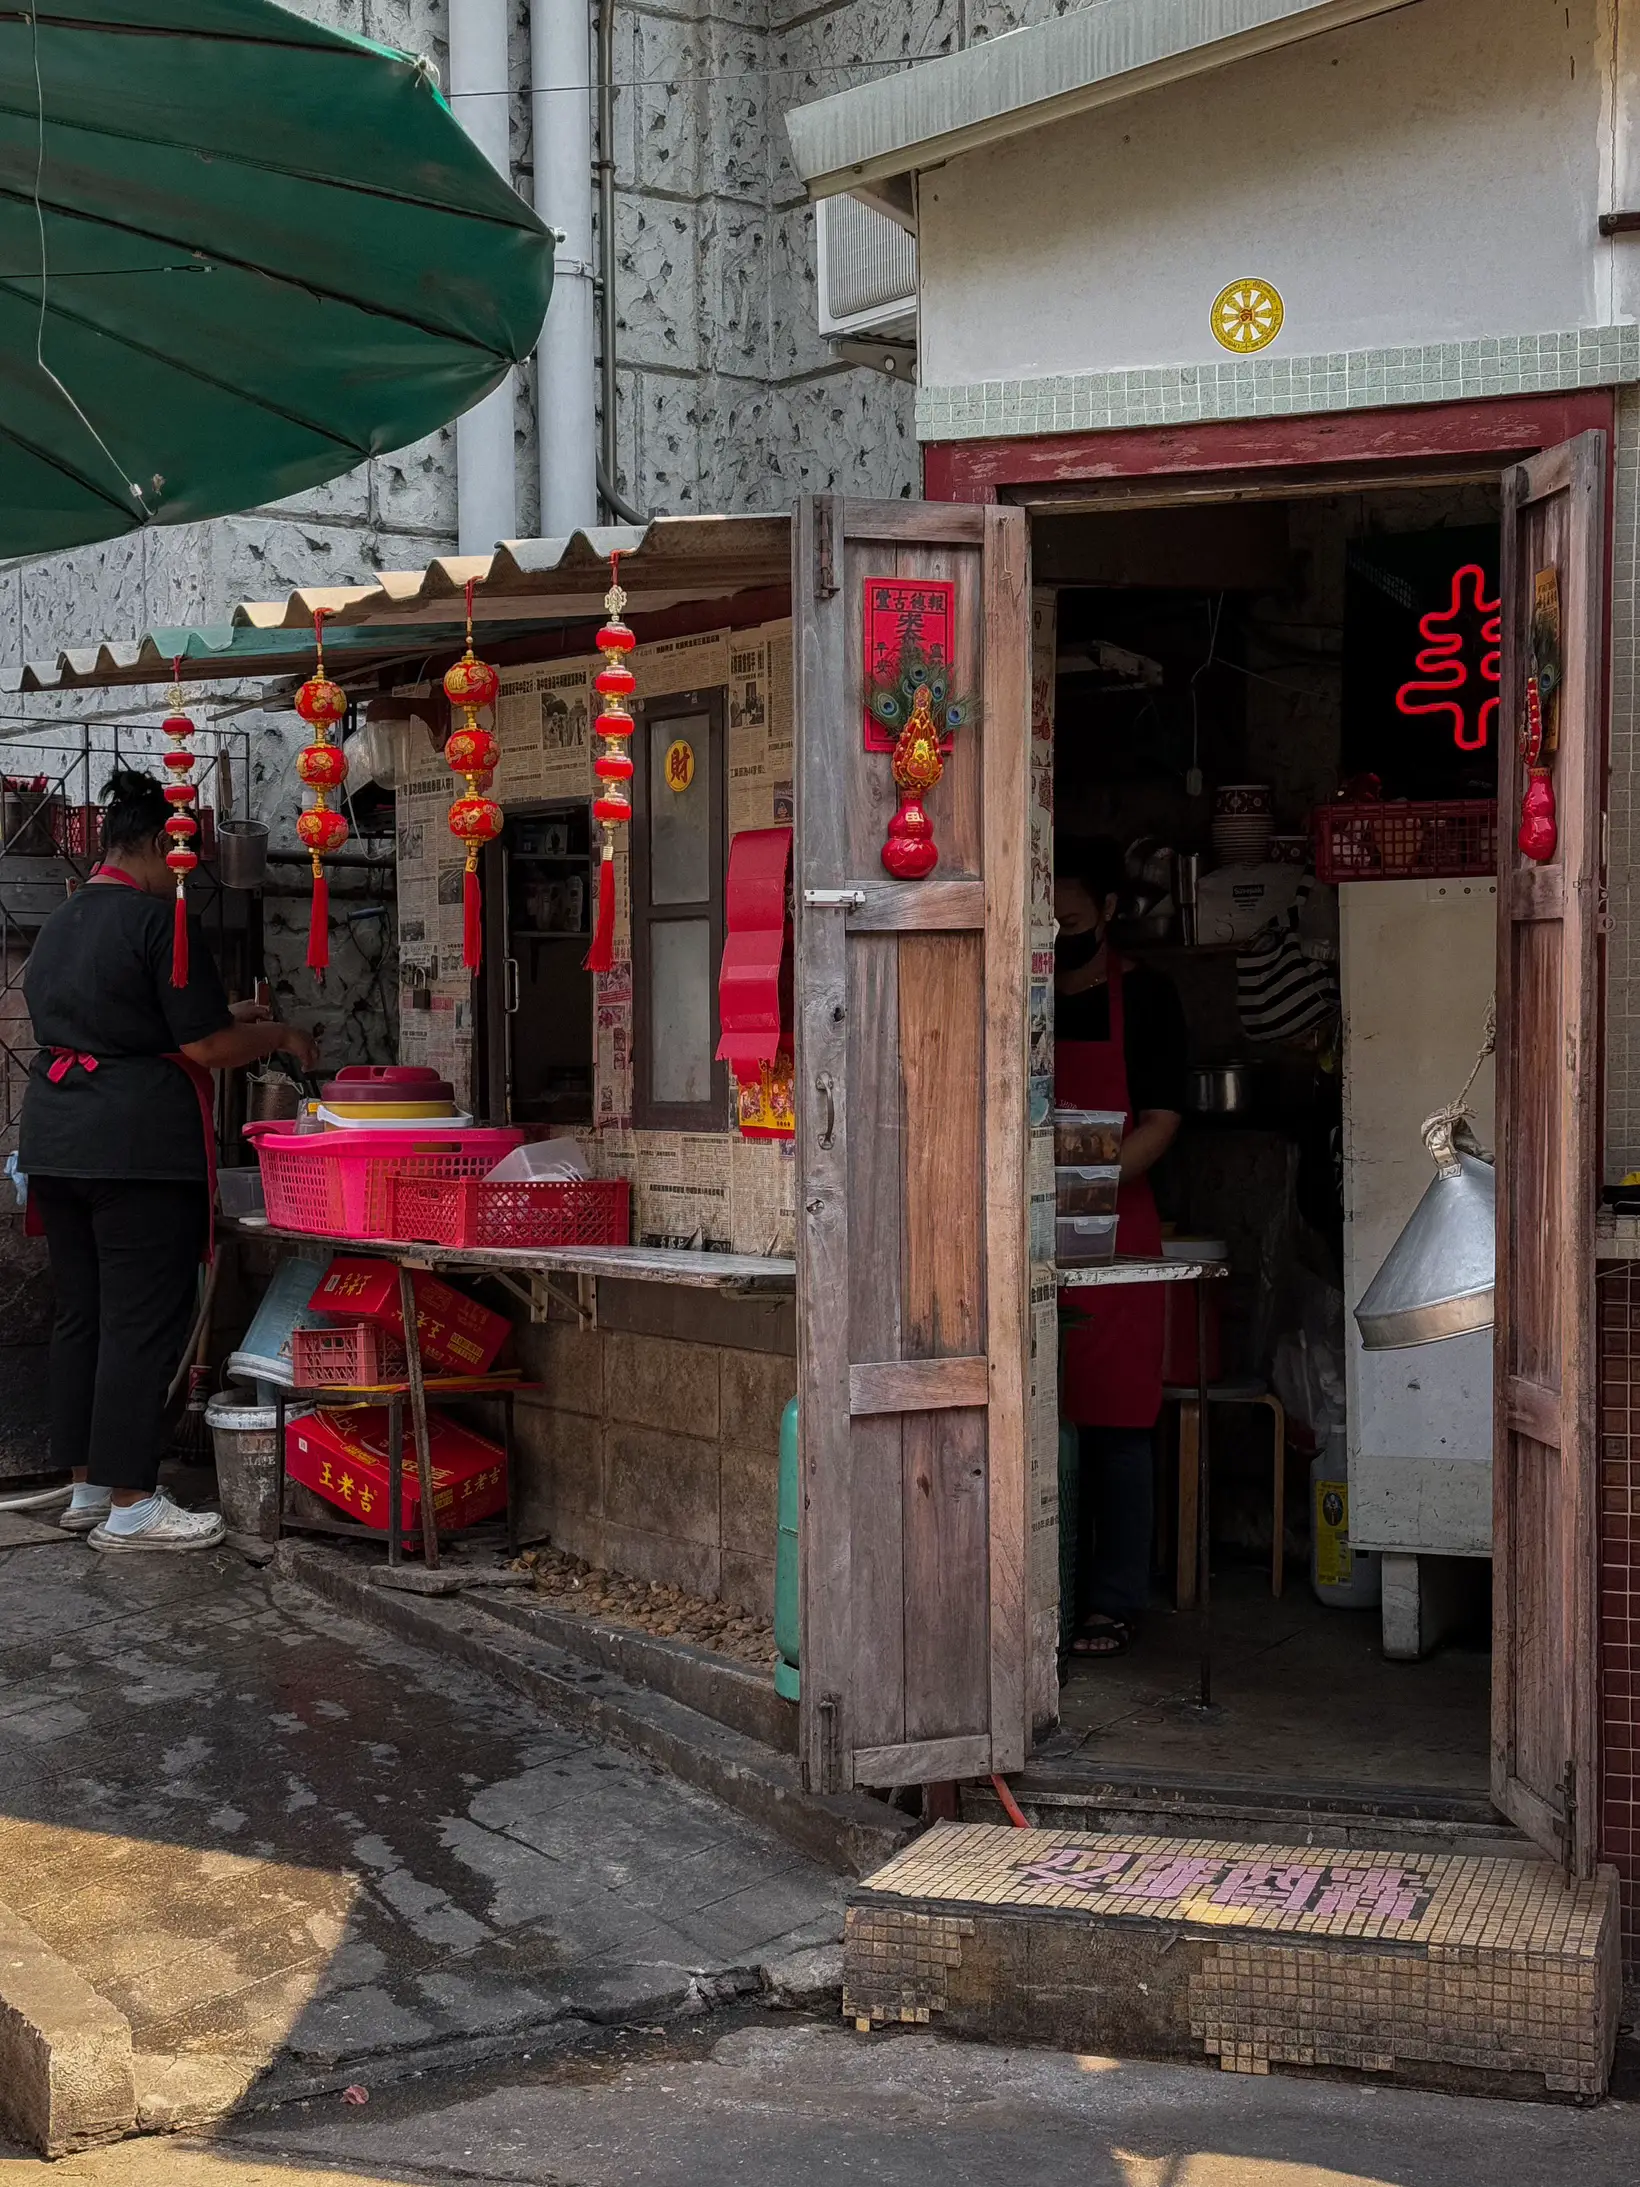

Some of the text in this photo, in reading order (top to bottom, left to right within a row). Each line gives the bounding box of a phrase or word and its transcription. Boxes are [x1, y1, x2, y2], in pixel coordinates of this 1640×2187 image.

[670, 746, 690, 783] 財
[318, 1462, 376, 1514] 王老吉
[461, 1467, 501, 1499] 王老吉
